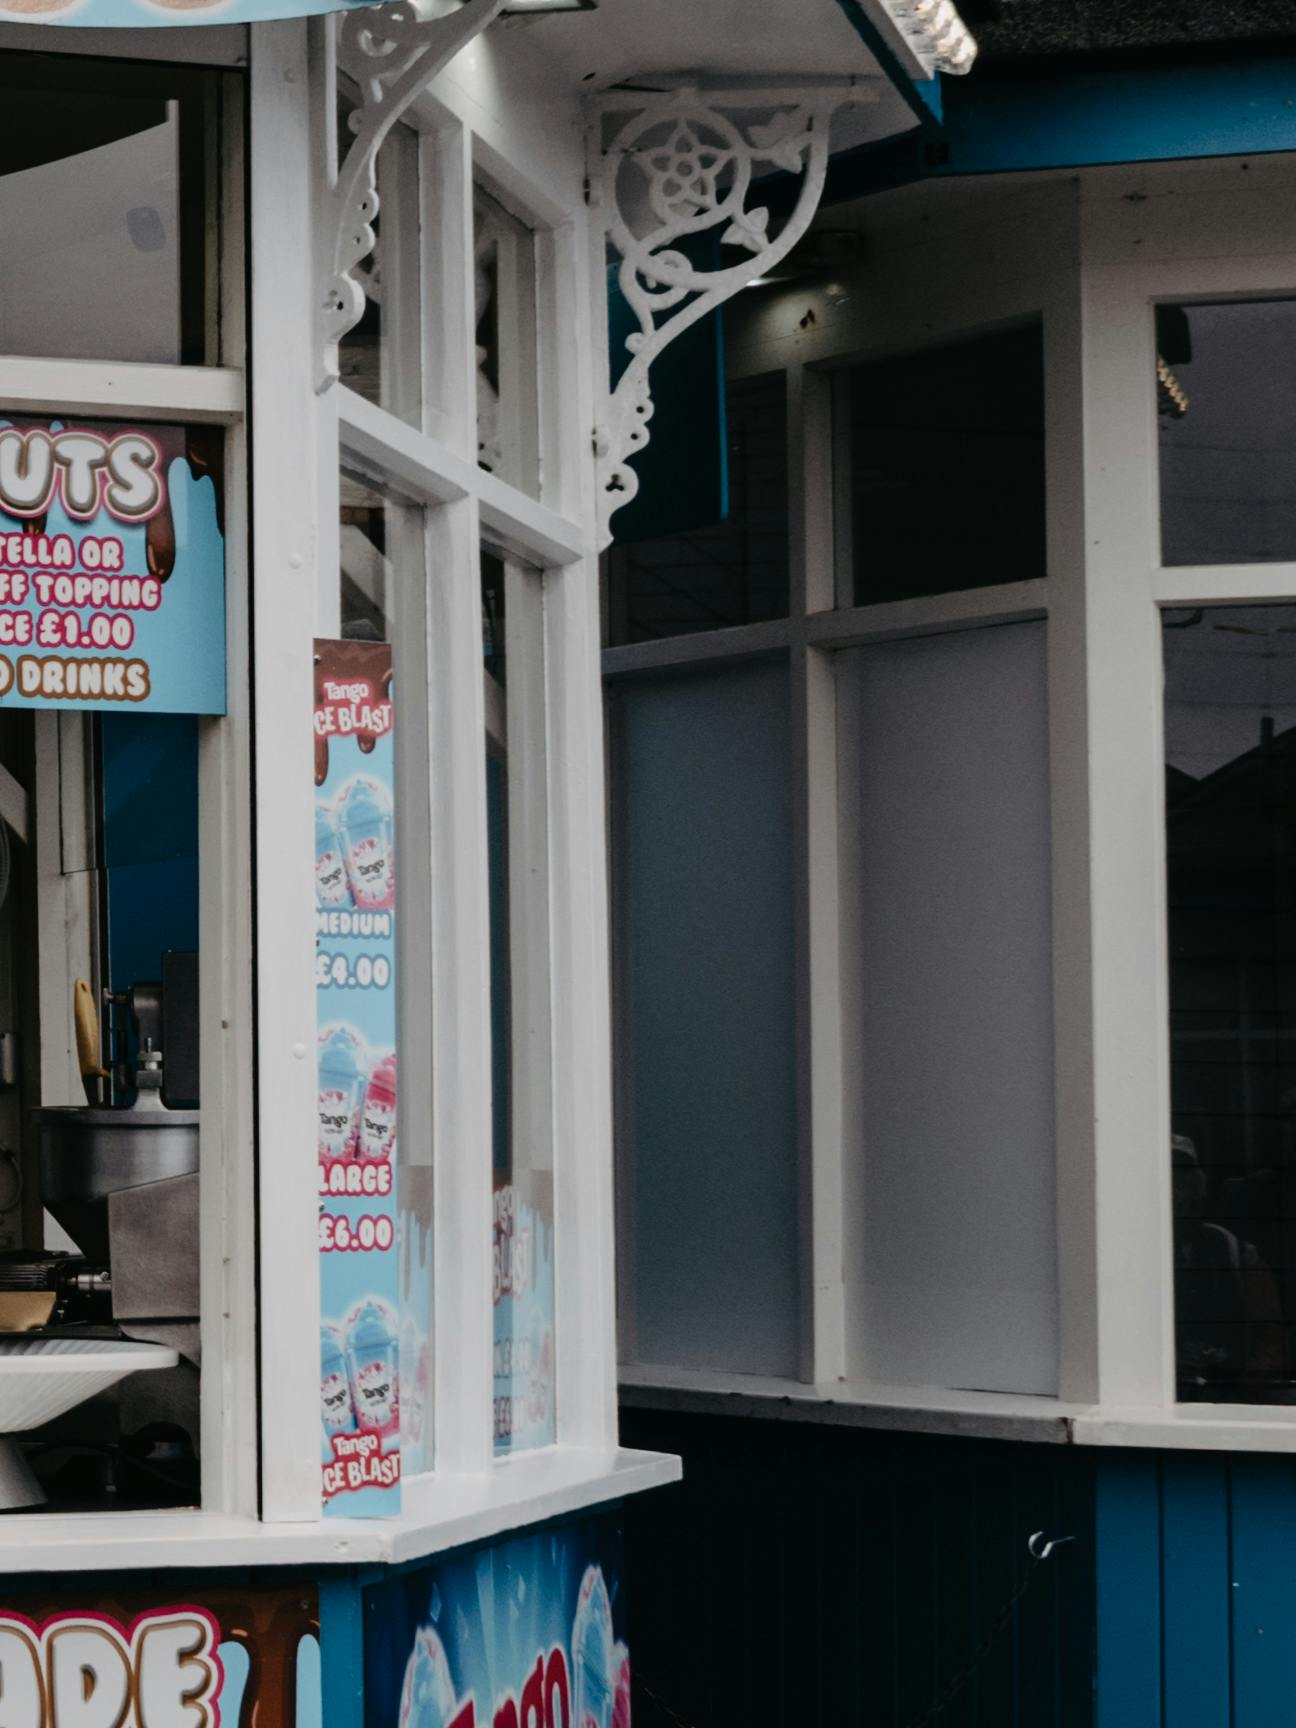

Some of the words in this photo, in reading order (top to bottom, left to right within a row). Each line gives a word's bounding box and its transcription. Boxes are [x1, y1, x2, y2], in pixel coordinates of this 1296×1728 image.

[79, 536, 123, 571] OR
[32, 572, 161, 610] TOPPING
[36, 609, 134, 650] £1.00
[16, 654, 150, 701] DRINKS
[323, 682, 369, 704] Tango
[313, 706, 336, 735] CE
[338, 704, 392, 733] BLAST
[316, 908, 392, 939] MEDIUM
[316, 950, 392, 990] £4.00
[319, 1160, 392, 1196] LARGE
[319, 1213, 393, 1252] £6.00
[333, 1435, 377, 1456] Tango
[323, 1463, 345, 1492] CE
[348, 1454, 399, 1487] BLAST
